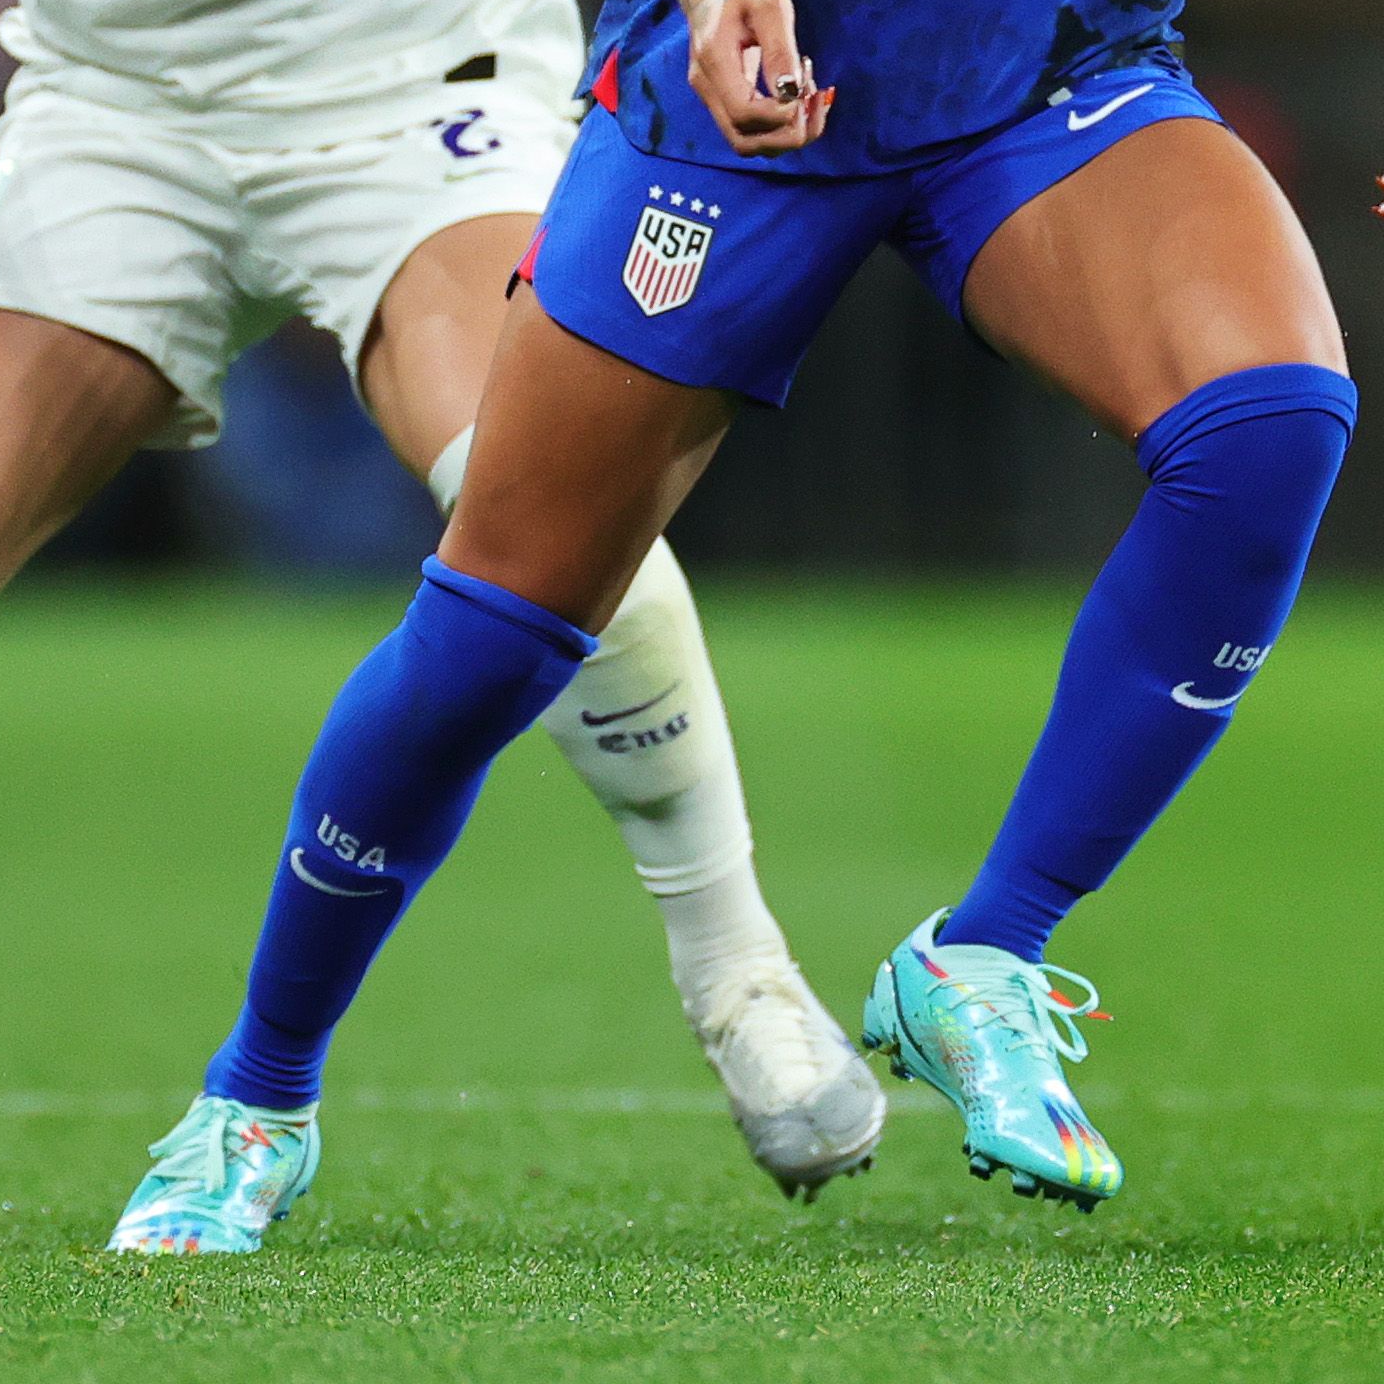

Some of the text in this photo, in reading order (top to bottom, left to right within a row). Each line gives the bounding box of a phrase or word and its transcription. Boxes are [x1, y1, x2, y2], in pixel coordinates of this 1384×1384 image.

[430, 108, 501, 158] 2
[643, 214, 706, 259] USA
[316, 813, 387, 873] USA
